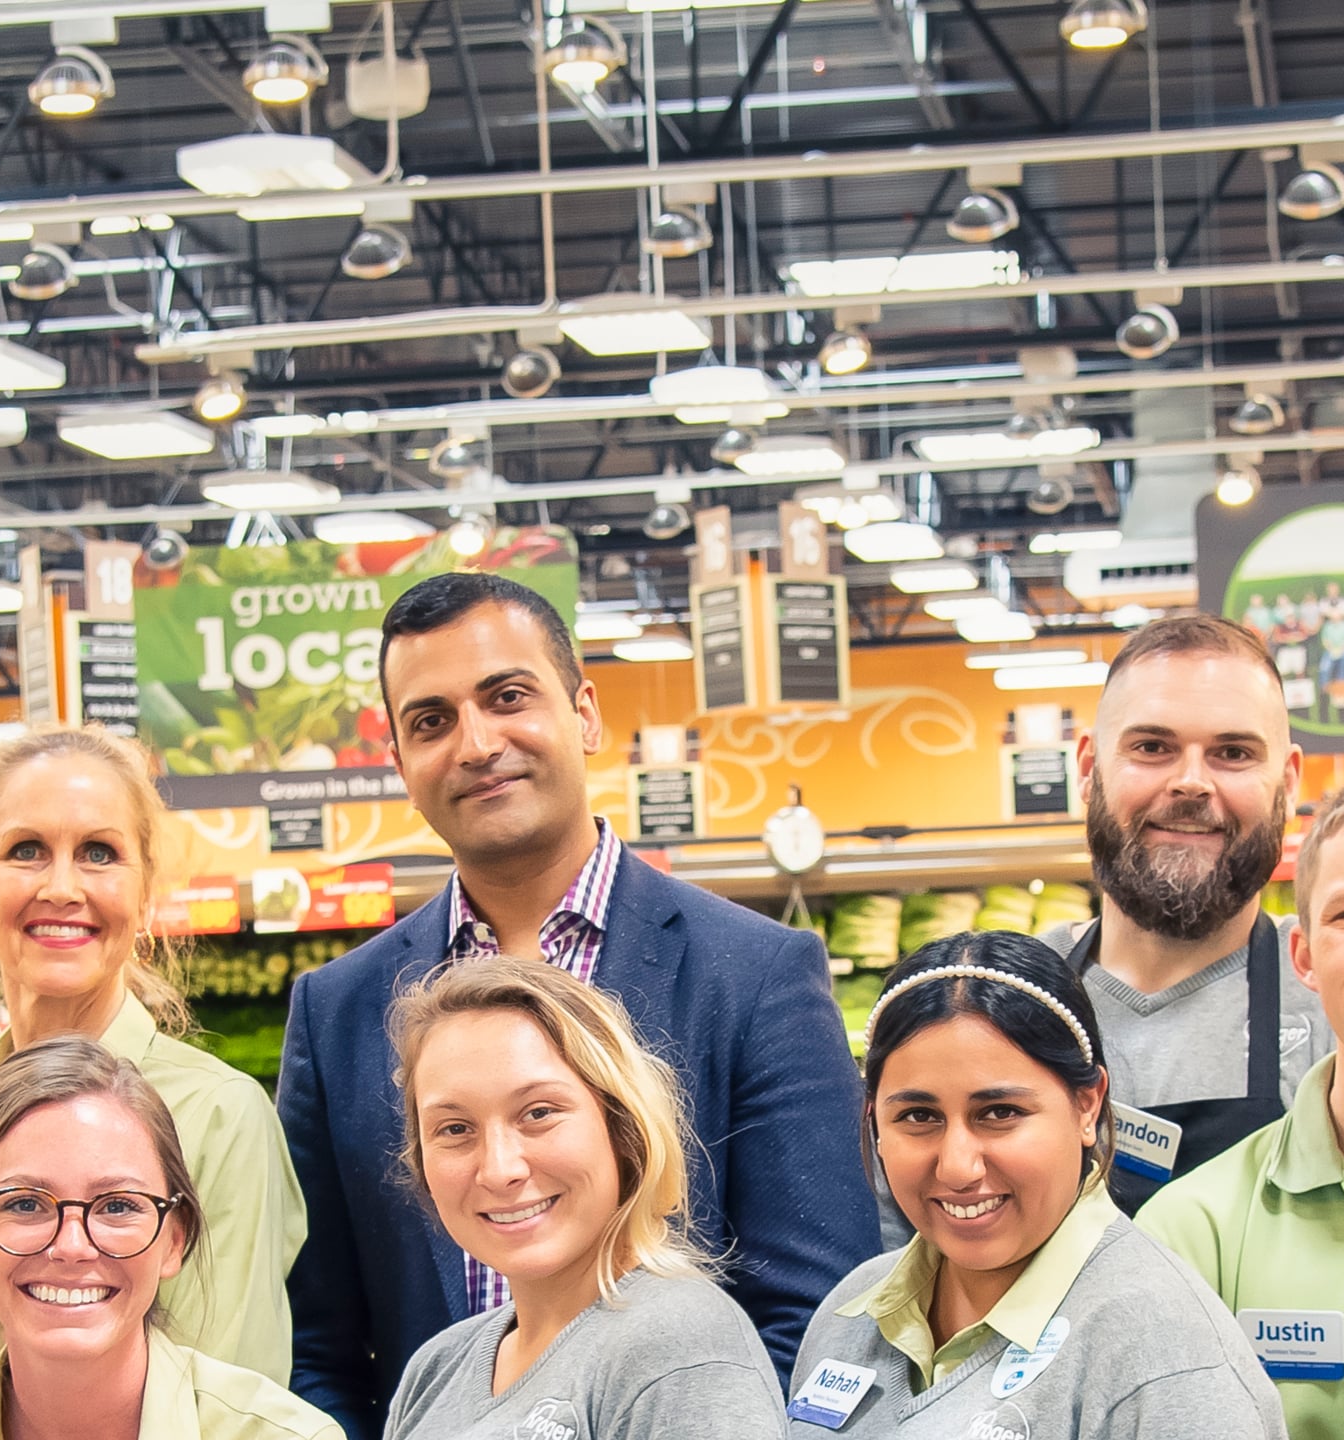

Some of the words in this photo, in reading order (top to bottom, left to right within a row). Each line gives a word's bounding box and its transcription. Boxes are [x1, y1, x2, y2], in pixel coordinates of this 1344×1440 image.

[231, 580, 384, 628] grown
[195, 617, 383, 691] loca
[260, 780, 325, 800] Grown
[348, 775, 380, 795] the
[1115, 1117, 1169, 1149] andon
[1255, 1320, 1325, 1342] Justin
